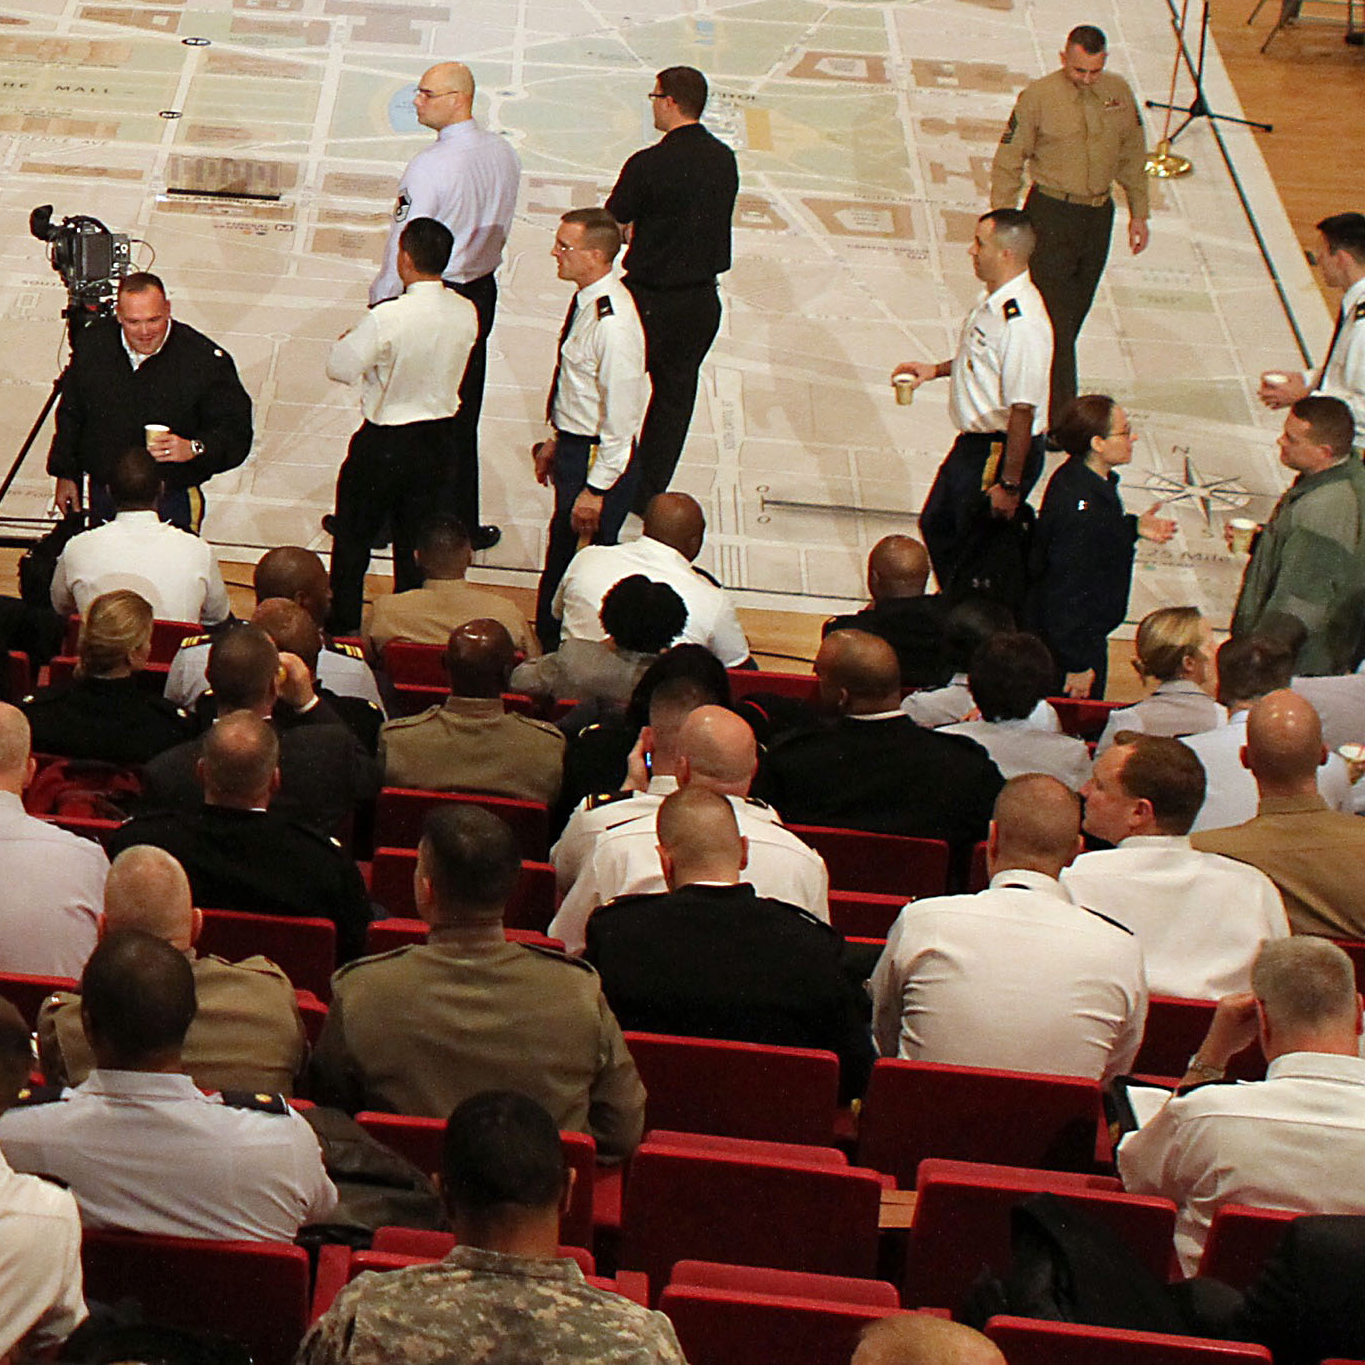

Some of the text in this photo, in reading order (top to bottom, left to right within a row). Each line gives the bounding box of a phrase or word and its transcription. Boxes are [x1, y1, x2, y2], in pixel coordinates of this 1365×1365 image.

[55, 85, 110, 94] MALL
[1172, 445, 1190, 454] N
[1180, 552, 1231, 563] Mile
